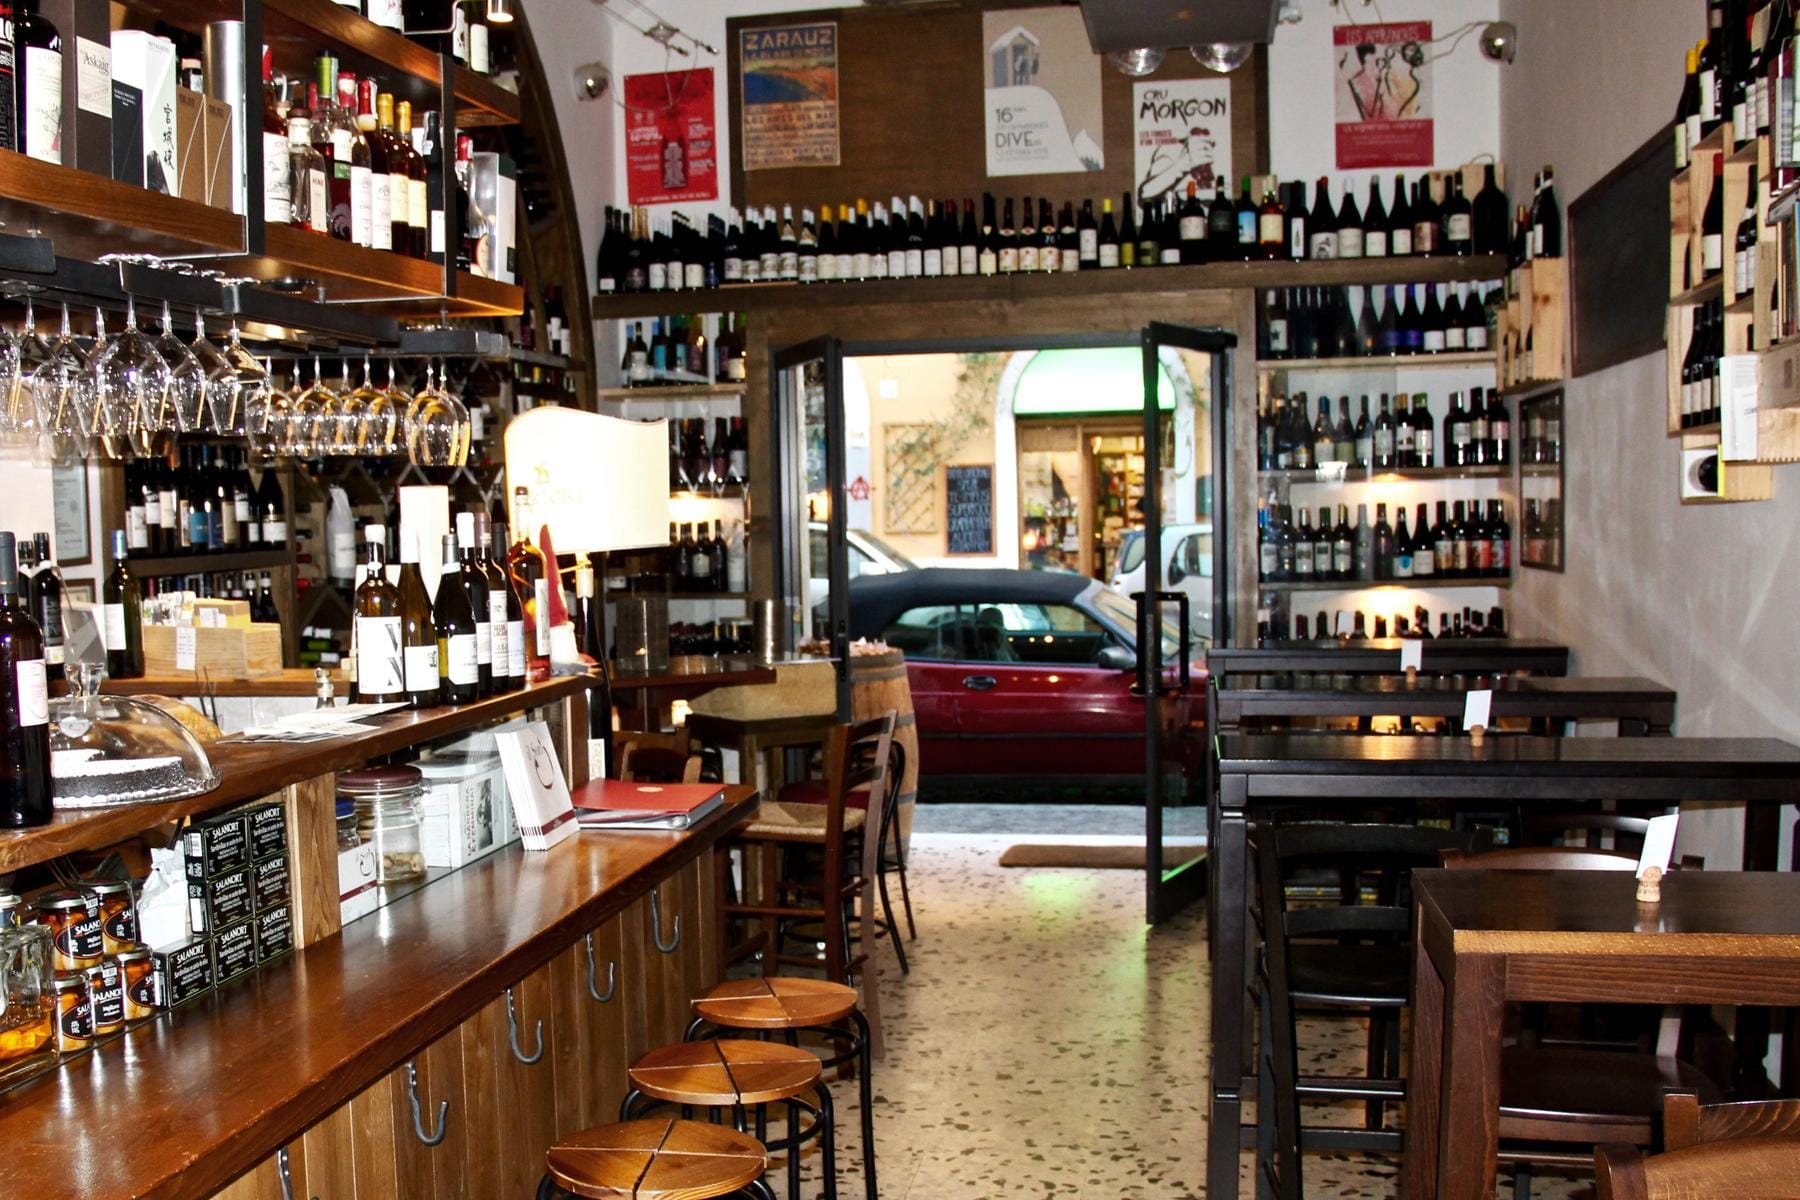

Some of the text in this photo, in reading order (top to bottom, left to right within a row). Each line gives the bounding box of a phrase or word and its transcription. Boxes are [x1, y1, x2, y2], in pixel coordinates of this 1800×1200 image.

[745, 28, 833, 50] ZARAUZ
[83, 52, 109, 76] Askaig
[1143, 89, 1169, 101] CRU
[995, 106, 1014, 123] 16
[1140, 98, 1227, 127] MORGON
[994, 130, 1034, 149] DIVE
[254, 807, 281, 823] SALANORT
[211, 821, 239, 838] SALANORT
[258, 857, 284, 874] SALANORT
[214, 873, 243, 890] SALANORT
[262, 908, 288, 925] SALANORT
[220, 925, 248, 944] SALANORT
[176, 944, 205, 964] SALANORT
